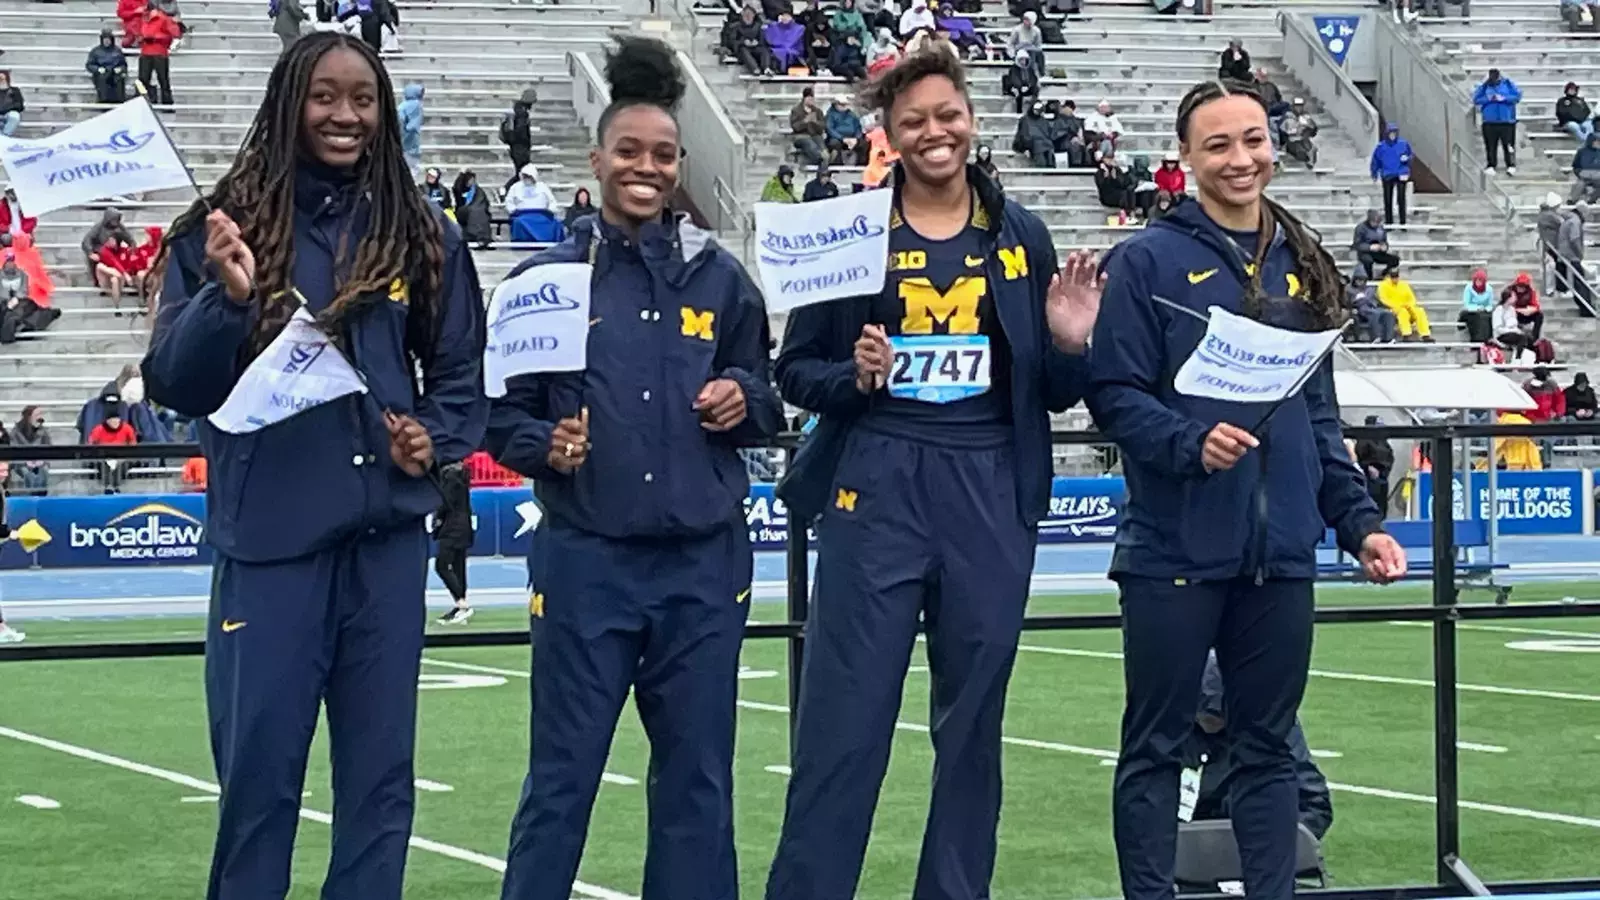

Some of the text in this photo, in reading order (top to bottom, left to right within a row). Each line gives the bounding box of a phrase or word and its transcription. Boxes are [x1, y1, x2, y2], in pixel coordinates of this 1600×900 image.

[998, 245, 1028, 280] M
[899, 276, 986, 335] M
[893, 350, 984, 384] 2747
[1047, 496, 1110, 516] RELAYS
[1523, 487, 1541, 501] OF
[1545, 487, 1572, 501] THE
[110, 547, 197, 559] MEDICAL CENTER
